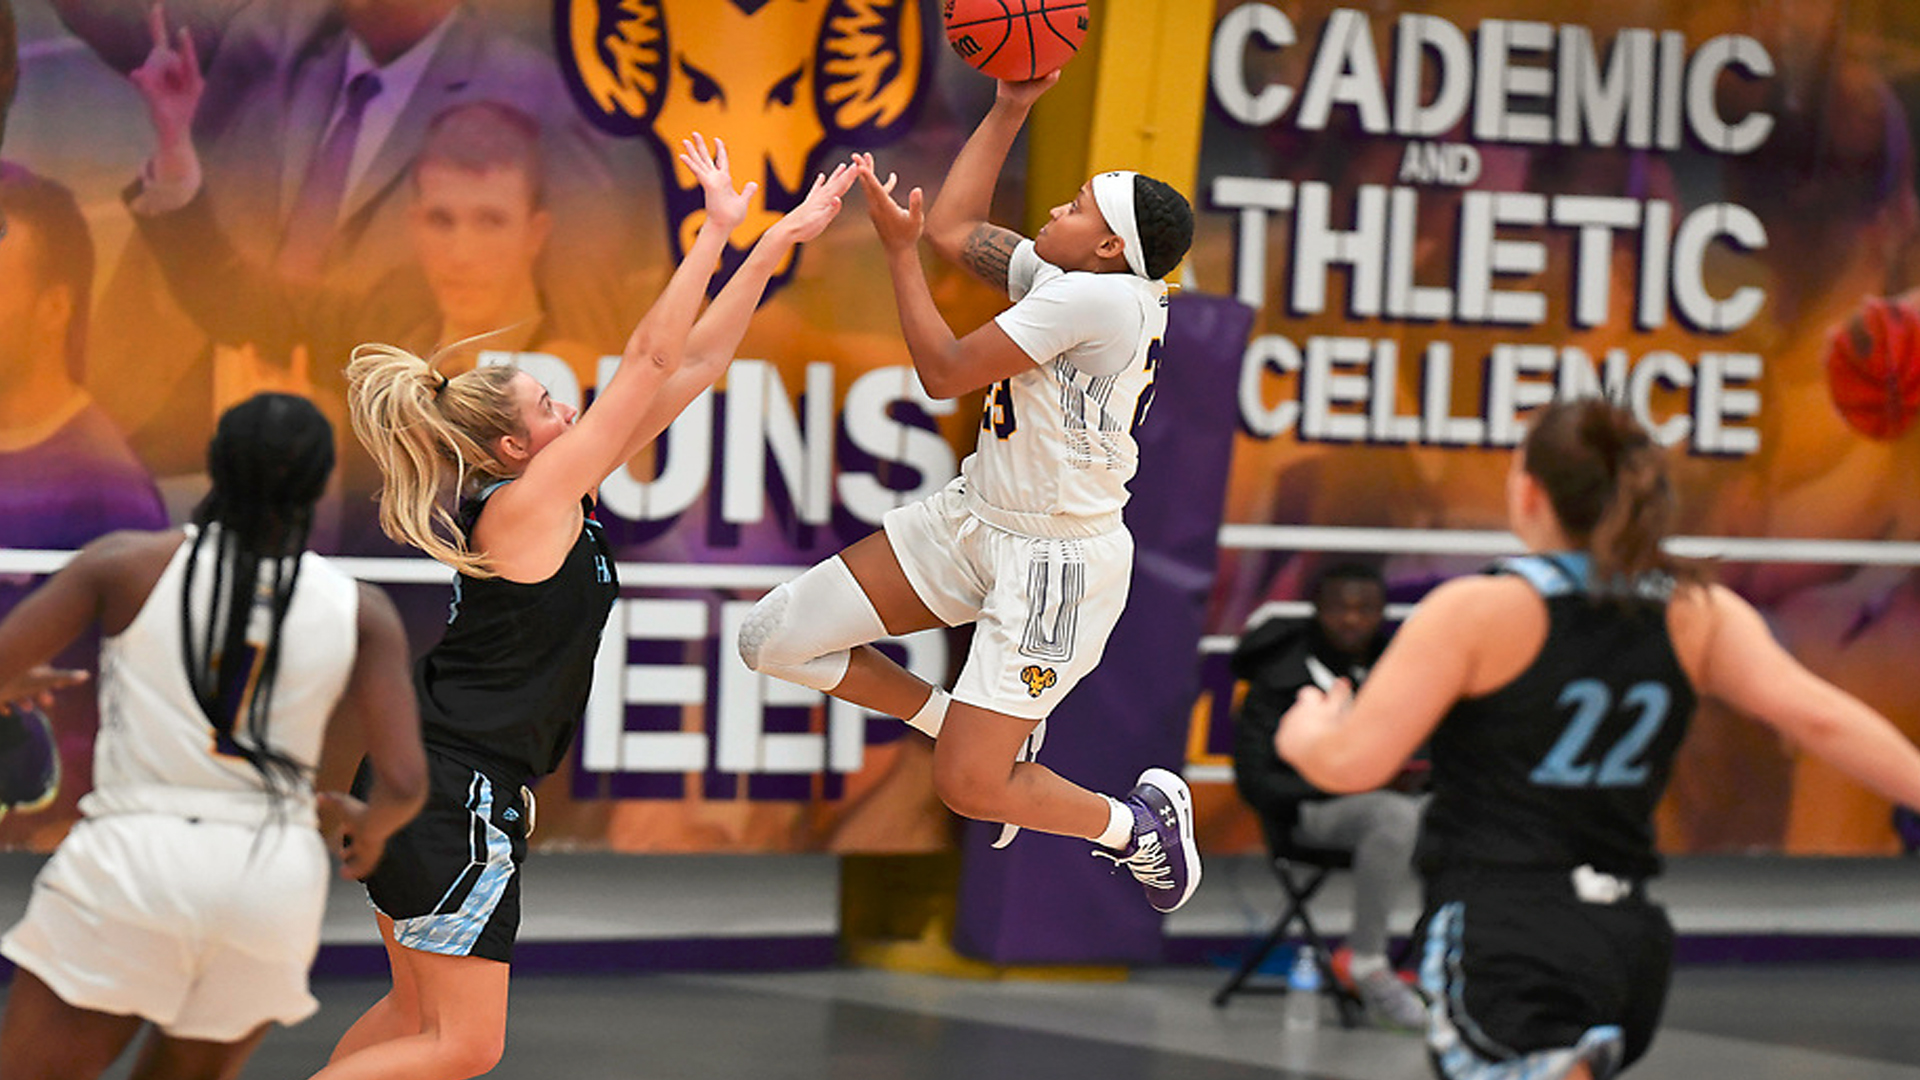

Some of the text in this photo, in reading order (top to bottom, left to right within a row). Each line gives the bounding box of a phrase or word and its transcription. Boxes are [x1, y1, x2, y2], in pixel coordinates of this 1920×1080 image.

[1210, 2, 1775, 154] CADEMIC
[1399, 141, 1482, 186] AND
[1182, 176, 1769, 332] THLETIC
[1528, 677, 1671, 787] 22
